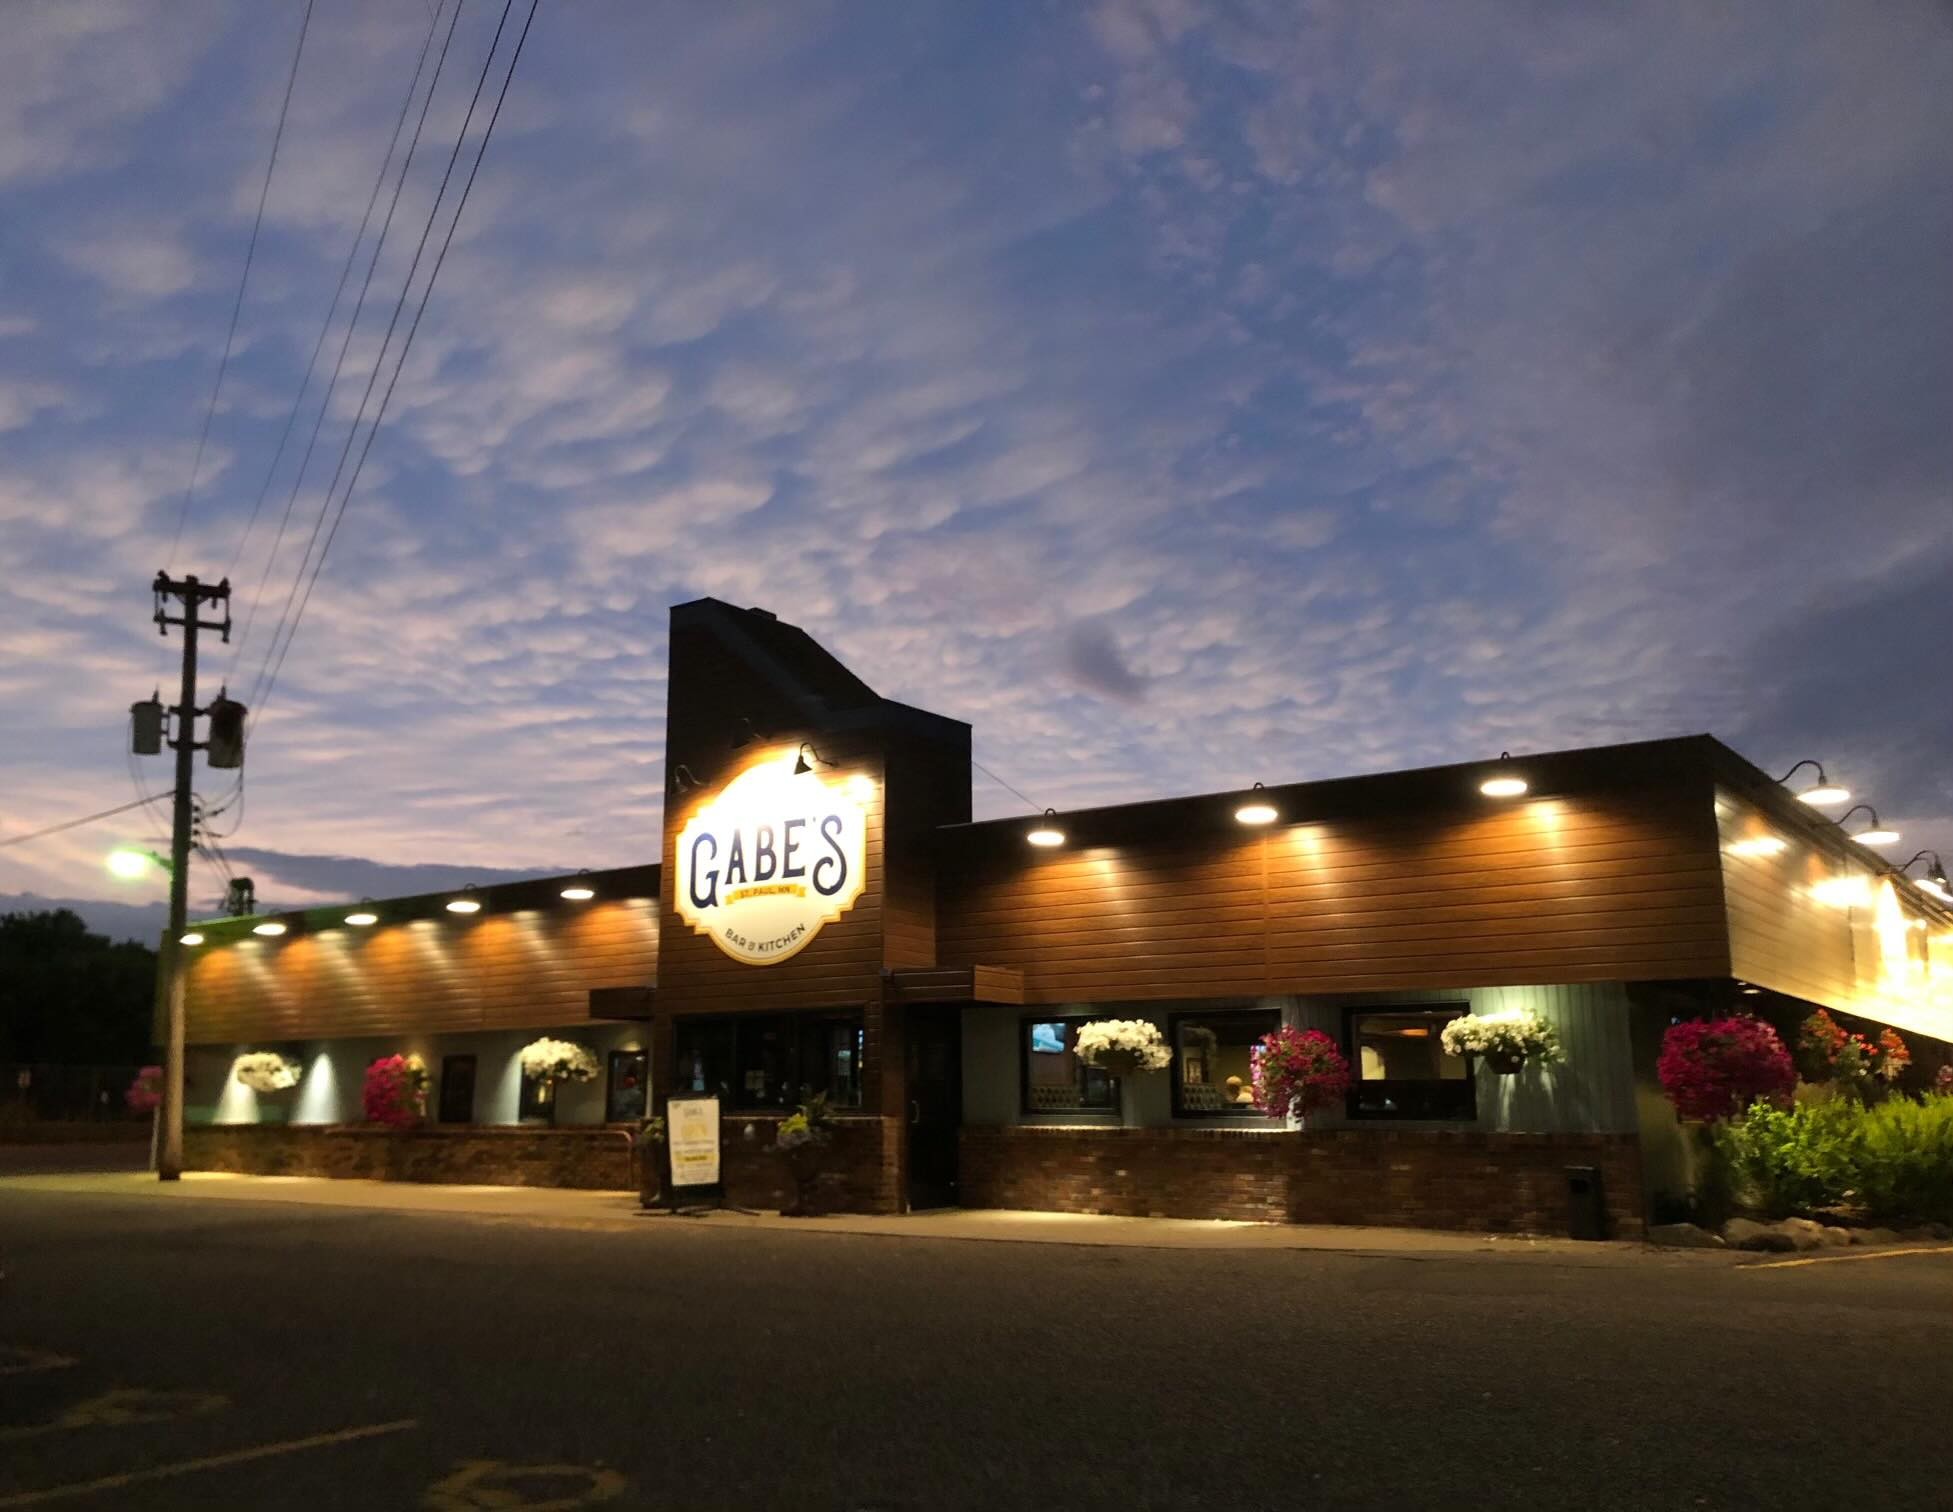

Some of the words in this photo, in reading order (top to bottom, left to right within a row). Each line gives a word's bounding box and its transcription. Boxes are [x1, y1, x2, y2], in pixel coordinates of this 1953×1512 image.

[690, 814, 848, 909] GABE'S
[725, 928, 747, 948] BAR
[757, 923, 806, 952] KITCHEN
